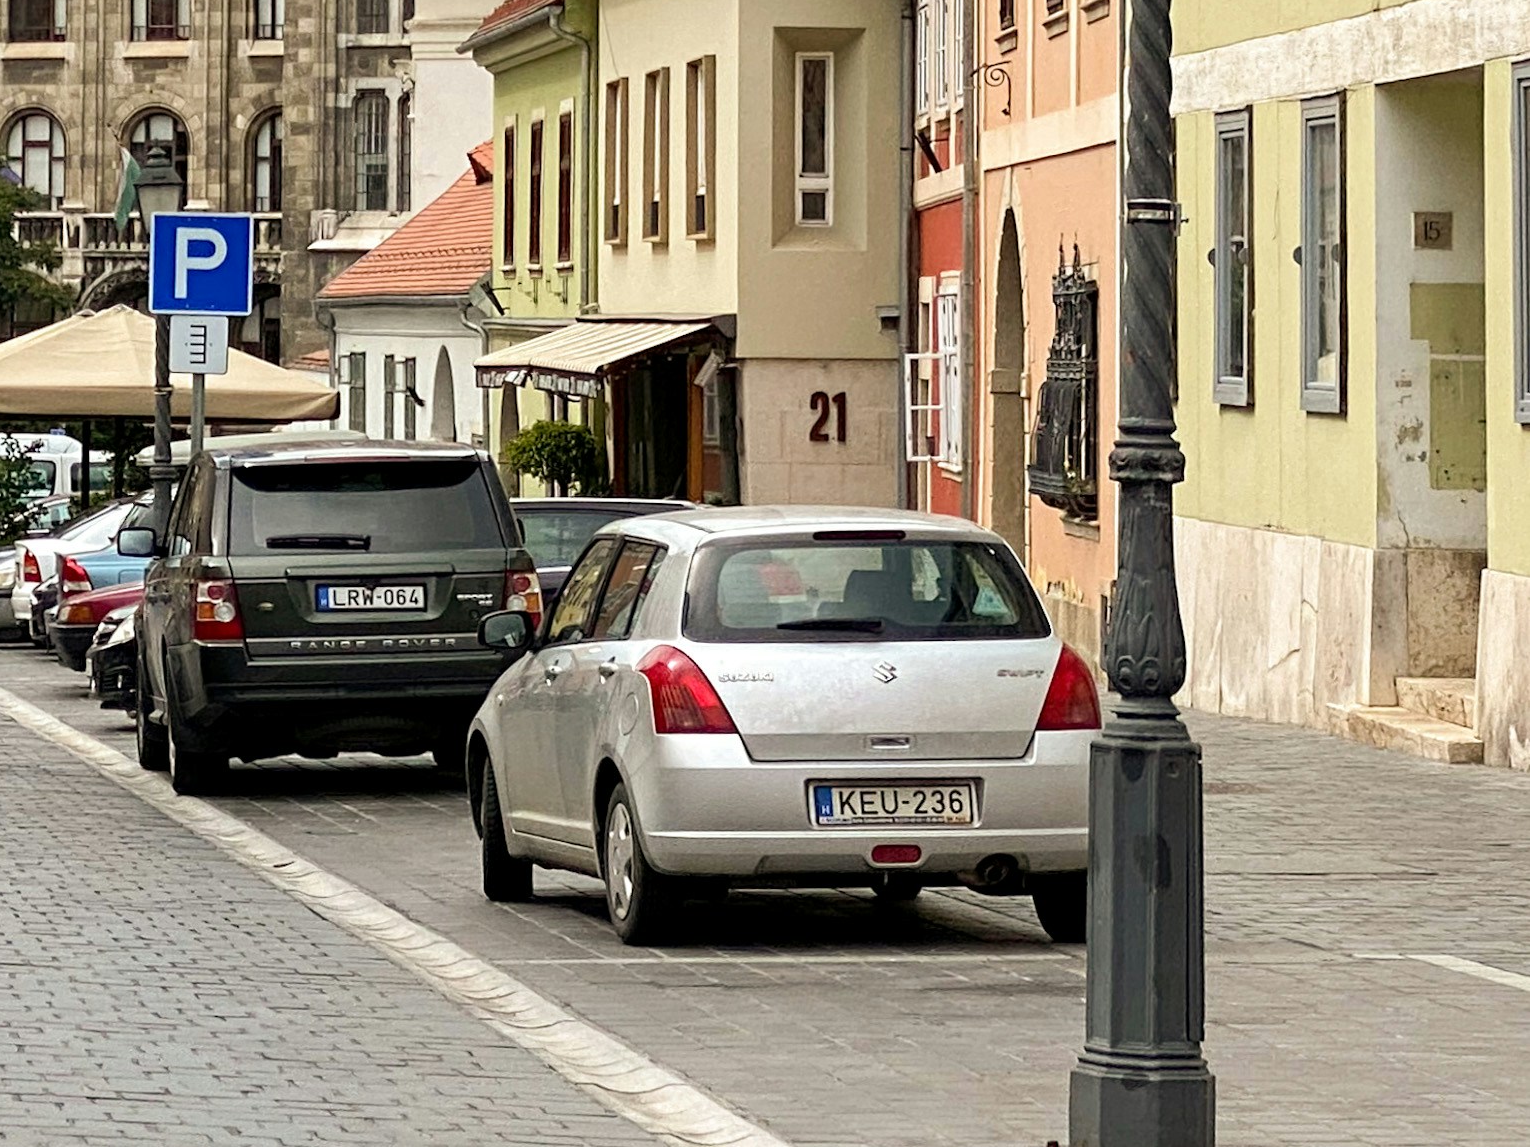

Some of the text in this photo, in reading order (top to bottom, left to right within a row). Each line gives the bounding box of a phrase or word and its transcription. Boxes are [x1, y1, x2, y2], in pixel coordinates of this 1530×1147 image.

[1423, 220, 1442, 242] 15
[174, 226, 228, 300] P
[809, 391, 847, 443] 21
[332, 588, 419, 607] LRW-064
[290, 637, 457, 650] RANGE ROVER
[838, 789, 964, 816] KEU-236
